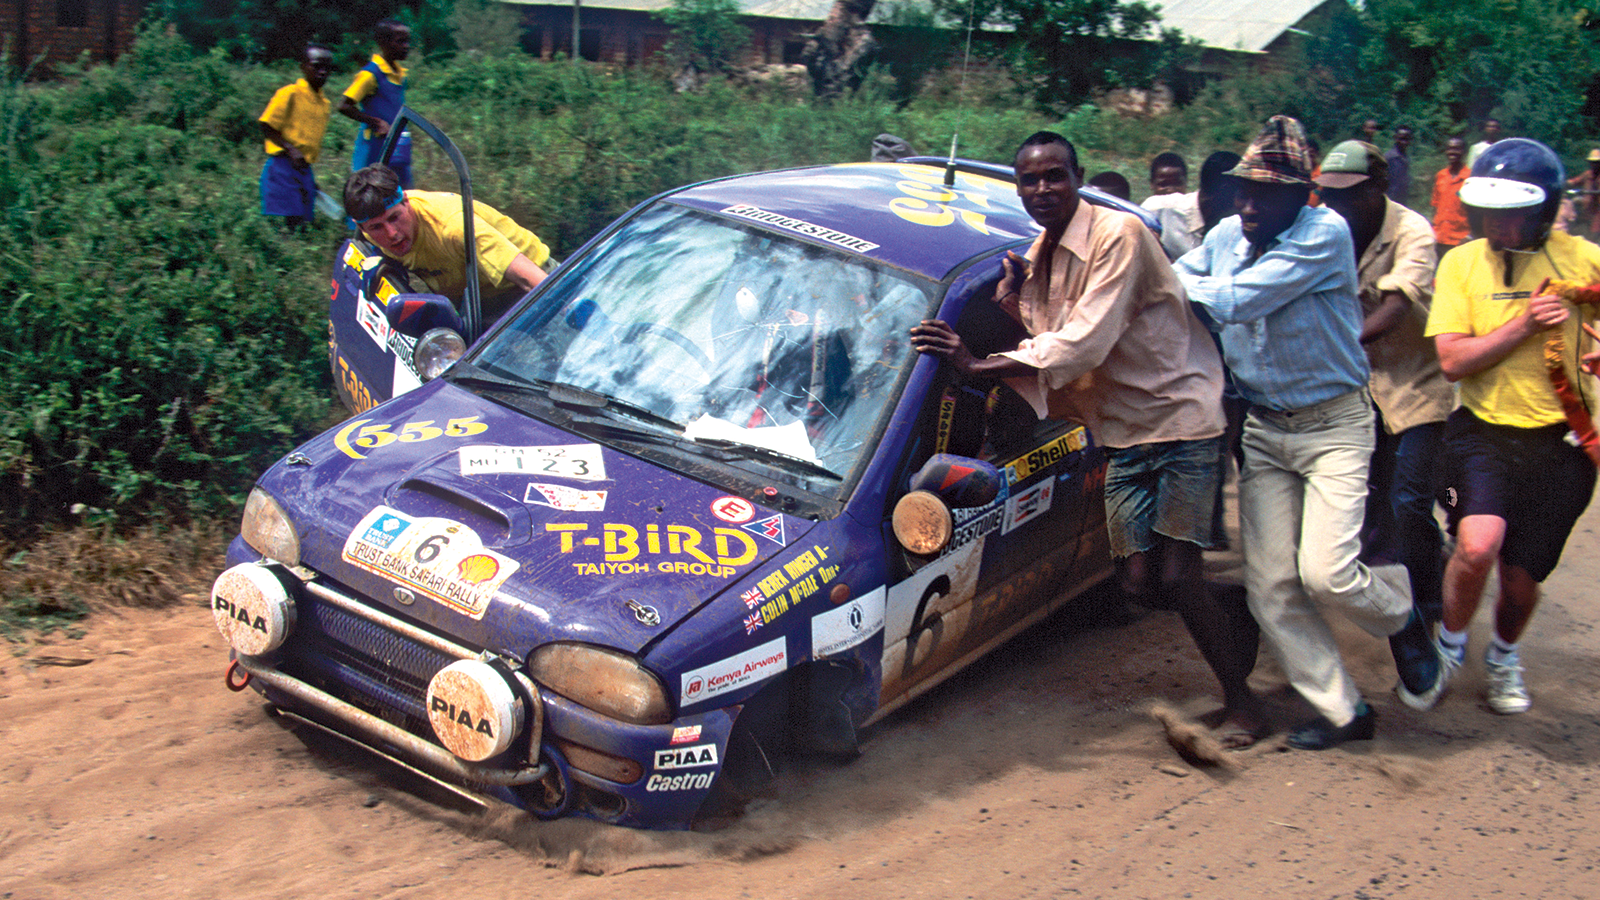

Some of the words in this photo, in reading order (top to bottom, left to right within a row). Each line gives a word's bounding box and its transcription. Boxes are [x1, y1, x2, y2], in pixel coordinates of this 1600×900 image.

[725, 204, 873, 251] BRIDGESTONE
[1027, 437, 1070, 474] Shell
[719, 500, 745, 518] E
[414, 535, 450, 564] 6
[353, 541, 382, 563] TRUST
[382, 554, 408, 576] BANK
[409, 565, 448, 592] SAFARI
[447, 583, 482, 607] RALLY
[573, 562, 650, 576] TAIYOH
[658, 562, 736, 578] GROUP
[757, 569, 790, 599] DEREK
[783, 550, 819, 580] RINGER
[215, 596, 268, 635] PIAA
[761, 593, 789, 624] COLIN
[900, 574, 952, 681] 6
[707, 669, 742, 688] Kenya
[743, 652, 784, 675] Airways
[431, 695, 494, 739] PIAA
[658, 748, 714, 767] PIAA
[645, 770, 715, 792] Castrol
